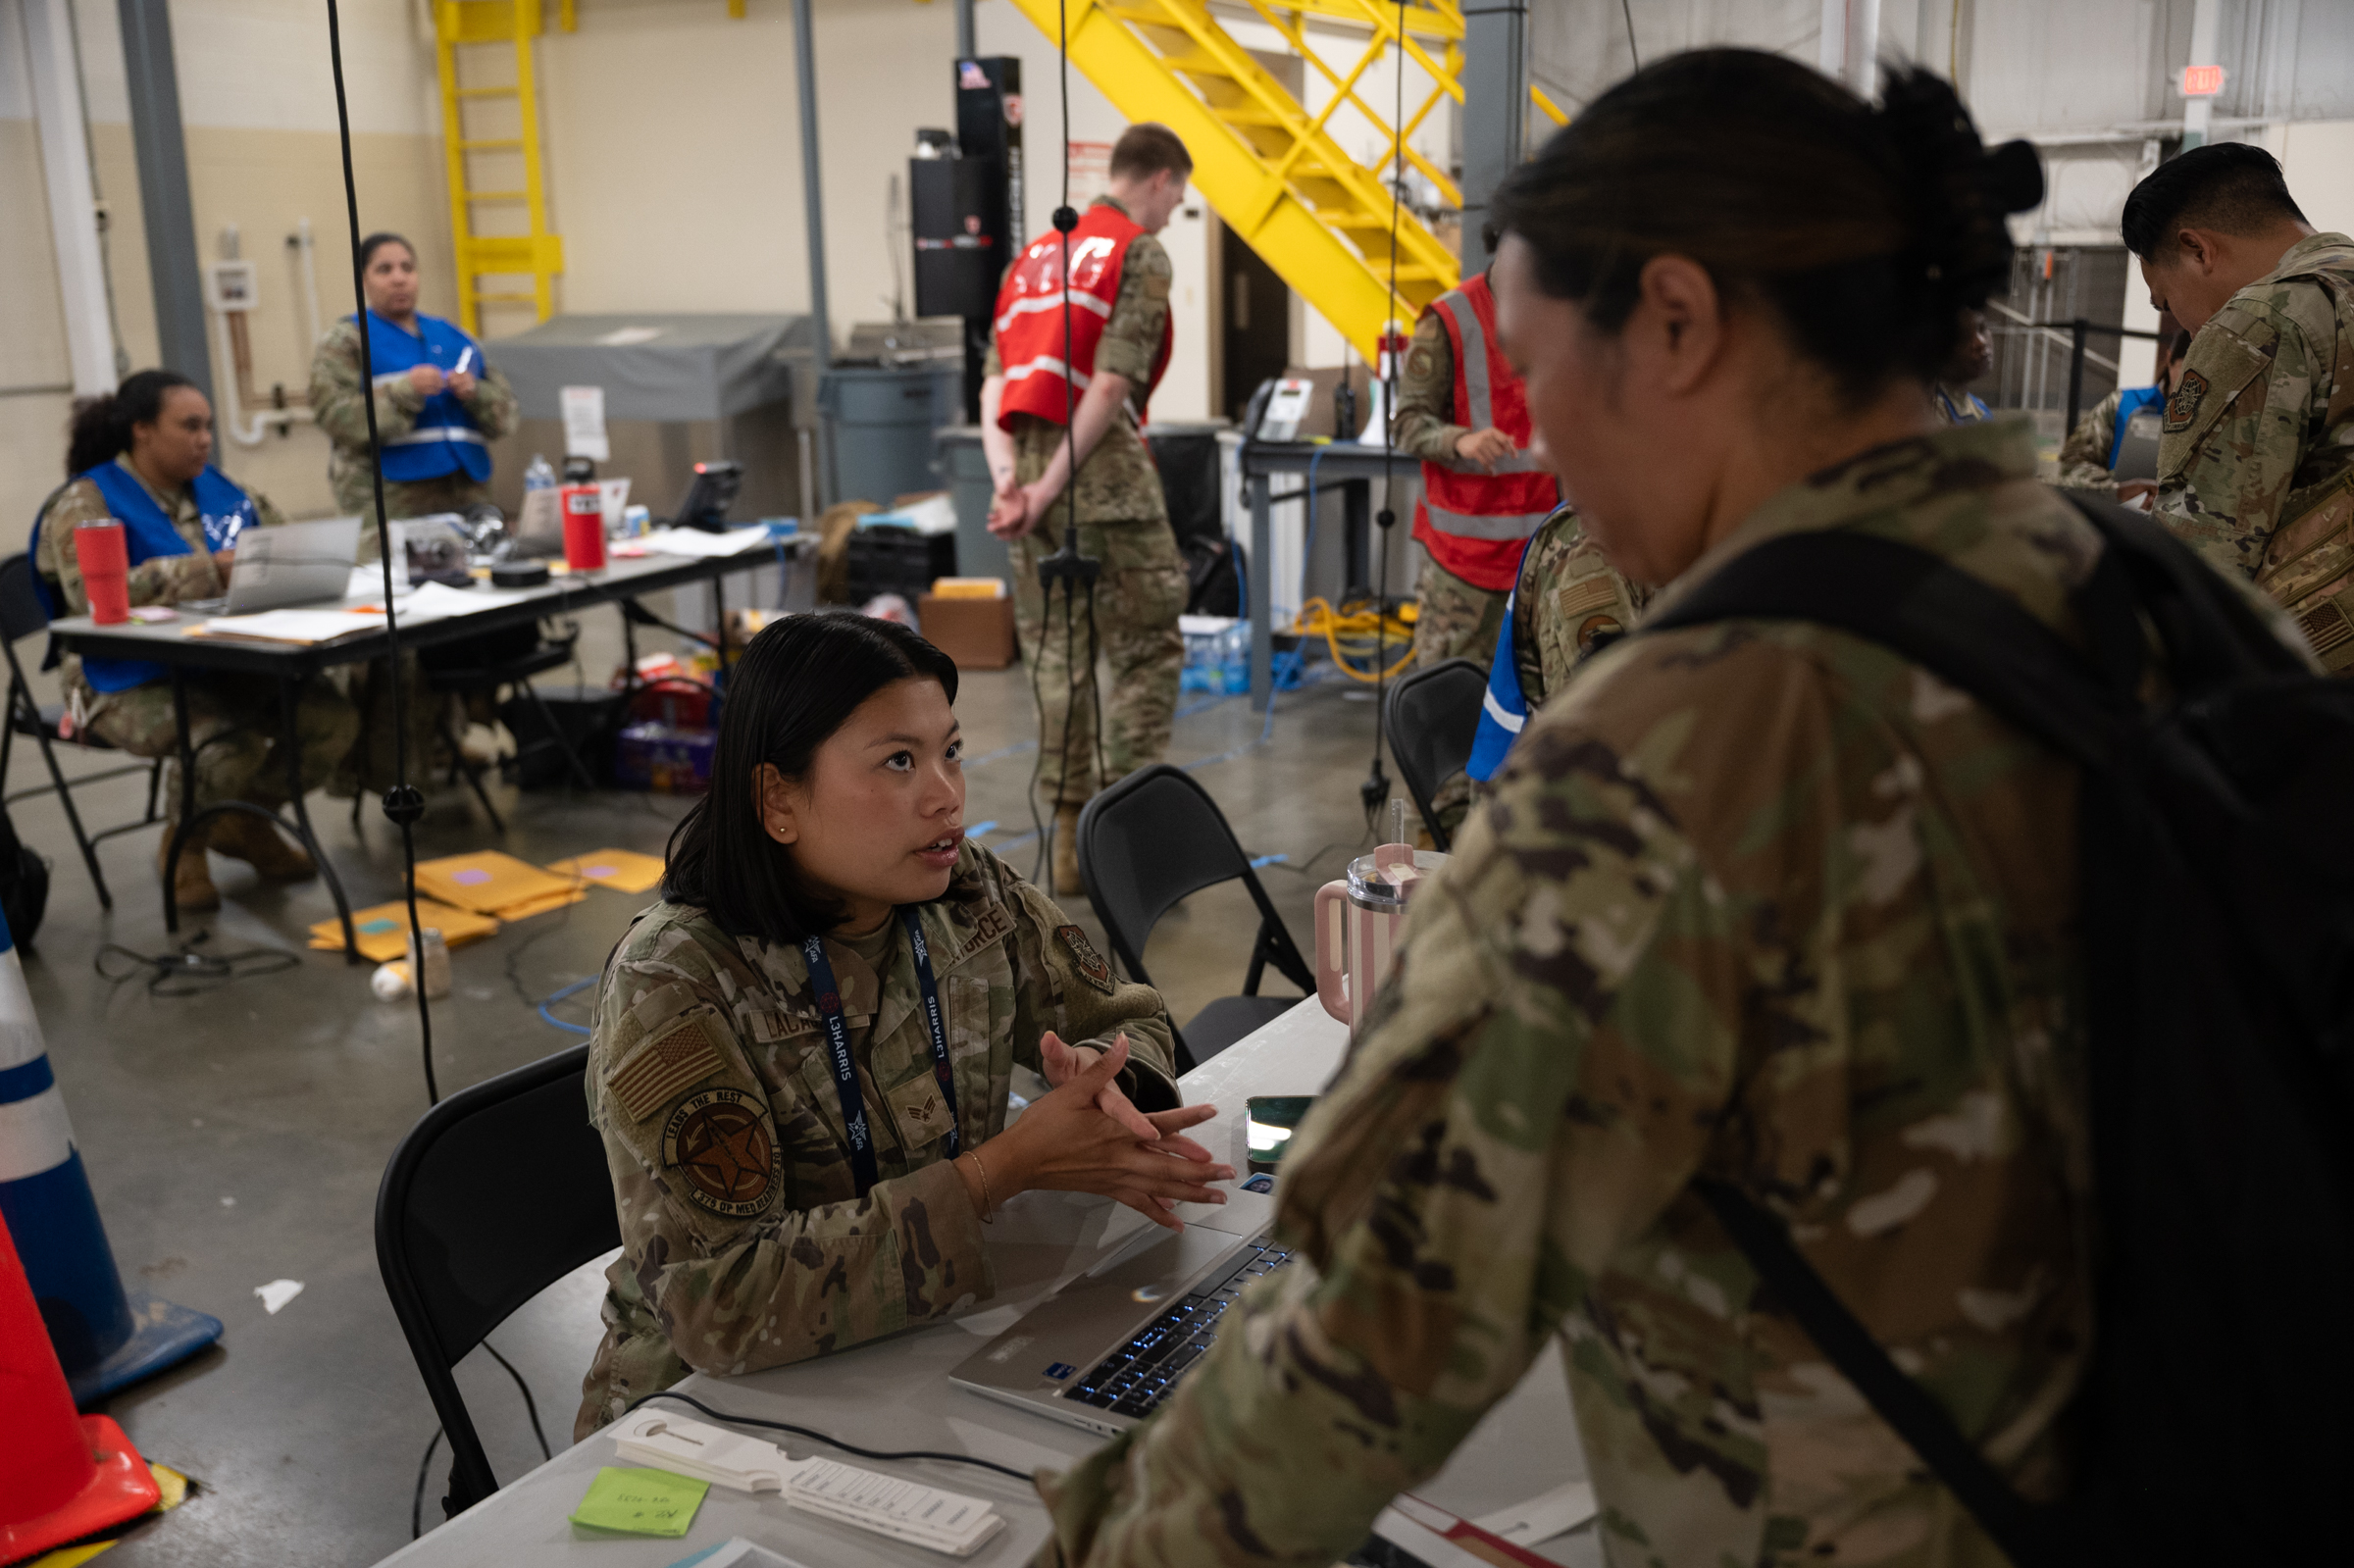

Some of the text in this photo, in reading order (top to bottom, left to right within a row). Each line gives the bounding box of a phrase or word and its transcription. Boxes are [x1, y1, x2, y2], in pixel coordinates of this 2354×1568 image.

[960, 909, 1008, 958] ORCE
[829, 1015, 852, 1082] L3HARRIS
[927, 995, 945, 1059] L3HARRIS
[667, 1090, 742, 1139] LEADS THE REST
[697, 1193, 717, 1208] 375
[736, 1202, 756, 1214] MED
[756, 1168, 780, 1210] READINESS
